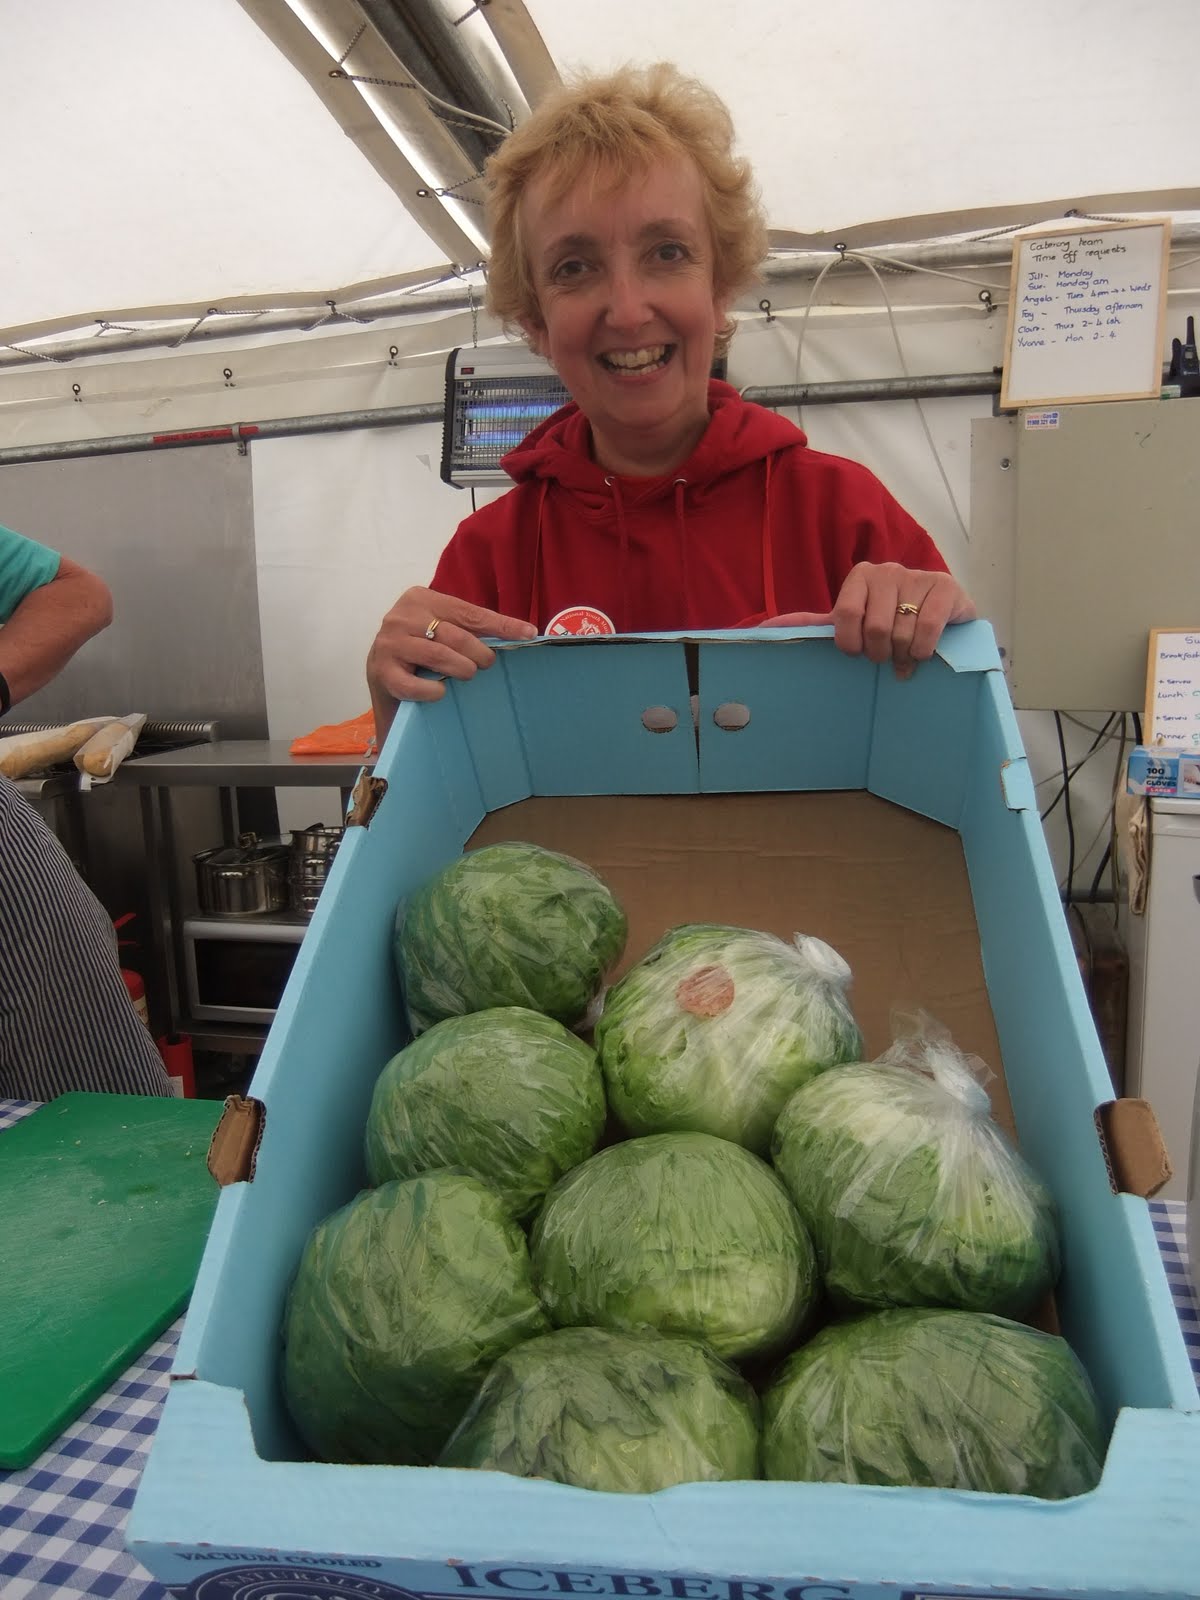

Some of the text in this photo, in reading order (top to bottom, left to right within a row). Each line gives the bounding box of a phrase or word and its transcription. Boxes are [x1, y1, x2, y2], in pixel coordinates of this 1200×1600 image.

[1030, 237, 1103, 252] Catering team
[1032, 244, 1127, 264] Time off requests
[1058, 269, 1093, 280] Monday
[1056, 278, 1089, 290] Monday
[1064, 305, 1100, 316] Thursday
[1105, 302, 1143, 315] afternoon
[1018, 336, 1045, 347] Yvonne
[1146, 767, 1165, 775] 100
[173, 1552, 382, 1568] VACUUM COOLED
[447, 1565, 851, 1600] ICEBERG
